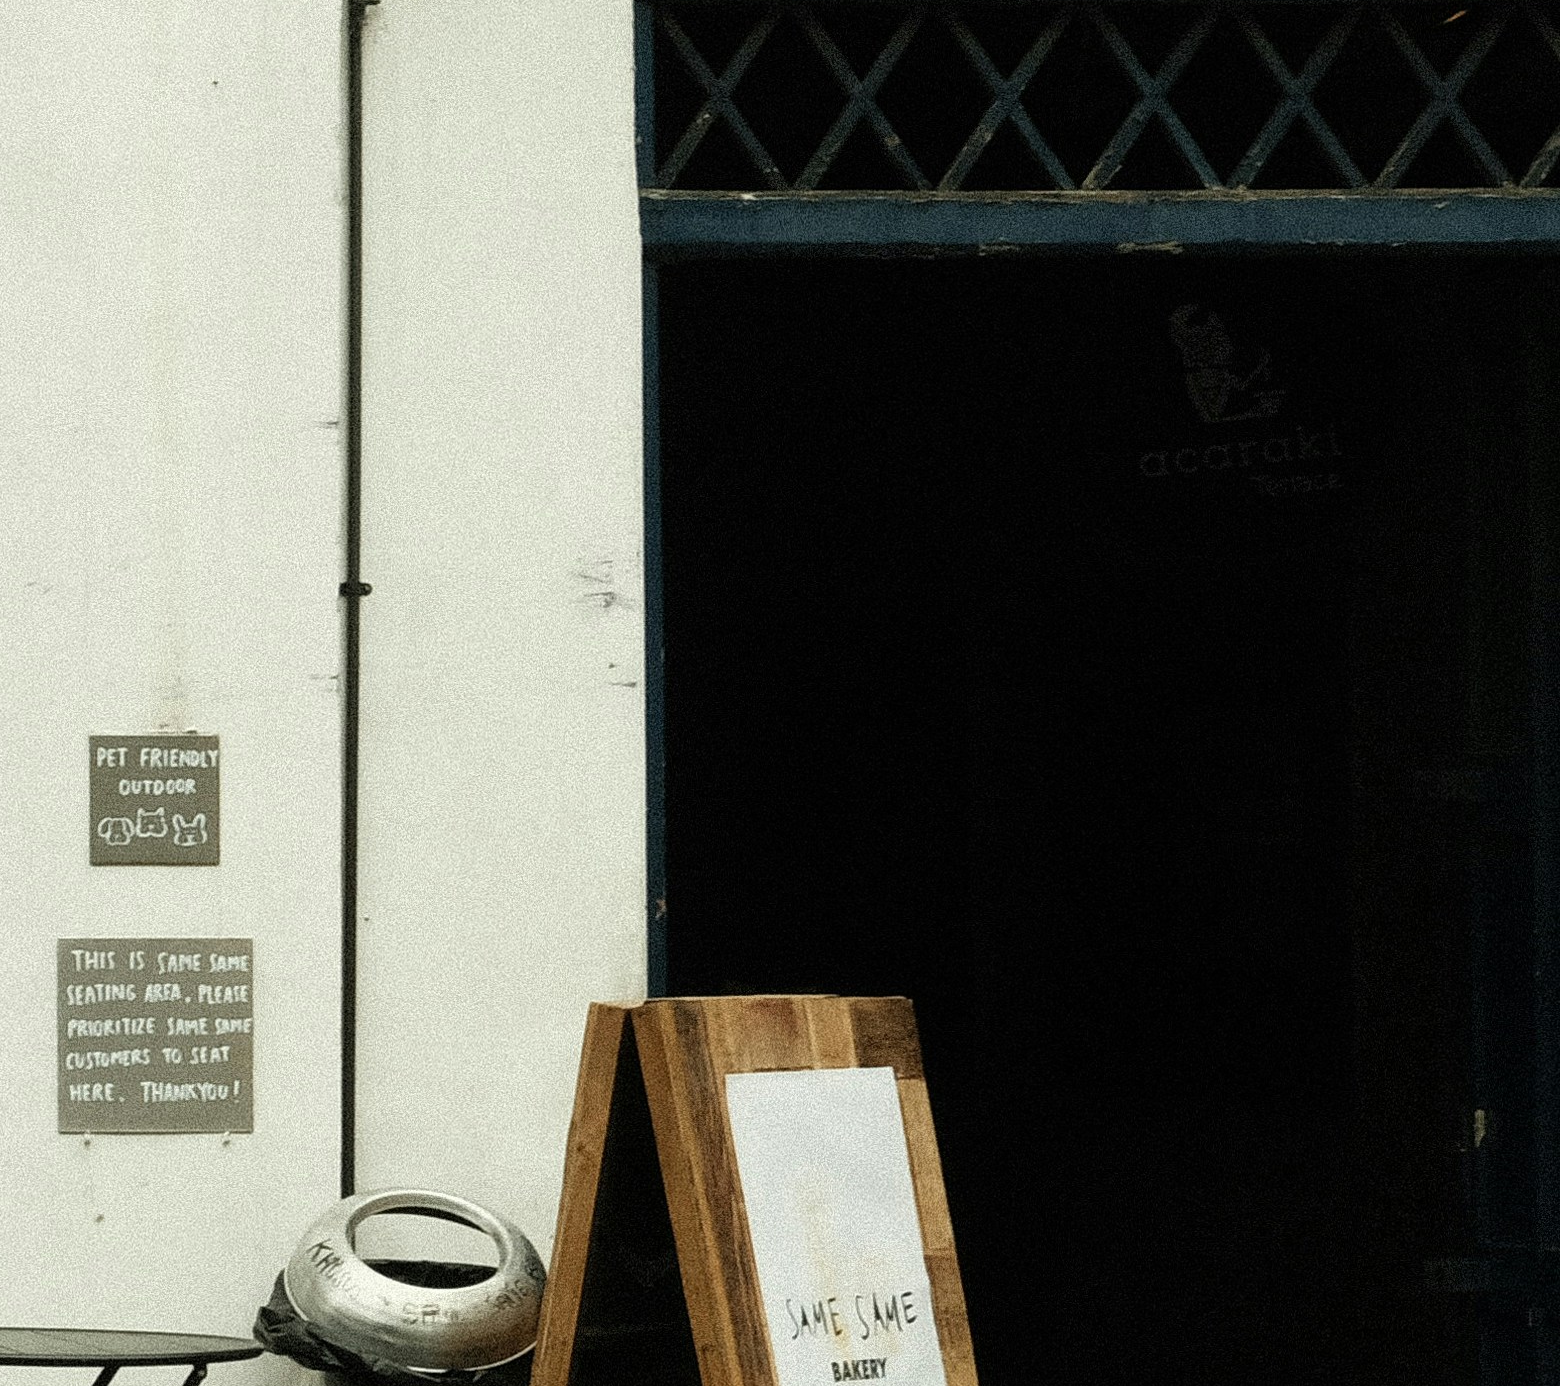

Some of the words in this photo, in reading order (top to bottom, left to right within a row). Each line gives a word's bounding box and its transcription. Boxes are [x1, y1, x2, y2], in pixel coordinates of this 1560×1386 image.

[96, 747, 129, 767] PET
[140, 747, 219, 768] FRIENDLY
[119, 779, 196, 795] OUTDOOR
[71, 950, 116, 971] THIS
[129, 950, 145, 970] IS
[158, 952, 202, 974] SAME
[210, 954, 249, 973] SAME
[66, 984, 137, 1005] SEATING
[198, 984, 249, 1004] PLEASE
[67, 1017, 155, 1038] PRIORITIZE
[167, 1017, 208, 1035] SAME
[214, 1018, 253, 1034] SAME
[66, 1048, 151, 1070] CUSTOMERS
[161, 1048, 182, 1064] TO
[190, 1046, 230, 1064] SEAT
[785, 1297, 843, 1340] SAME
[857, 1291, 918, 1339] SAME
[831, 1358, 887, 1382] BAKERY
